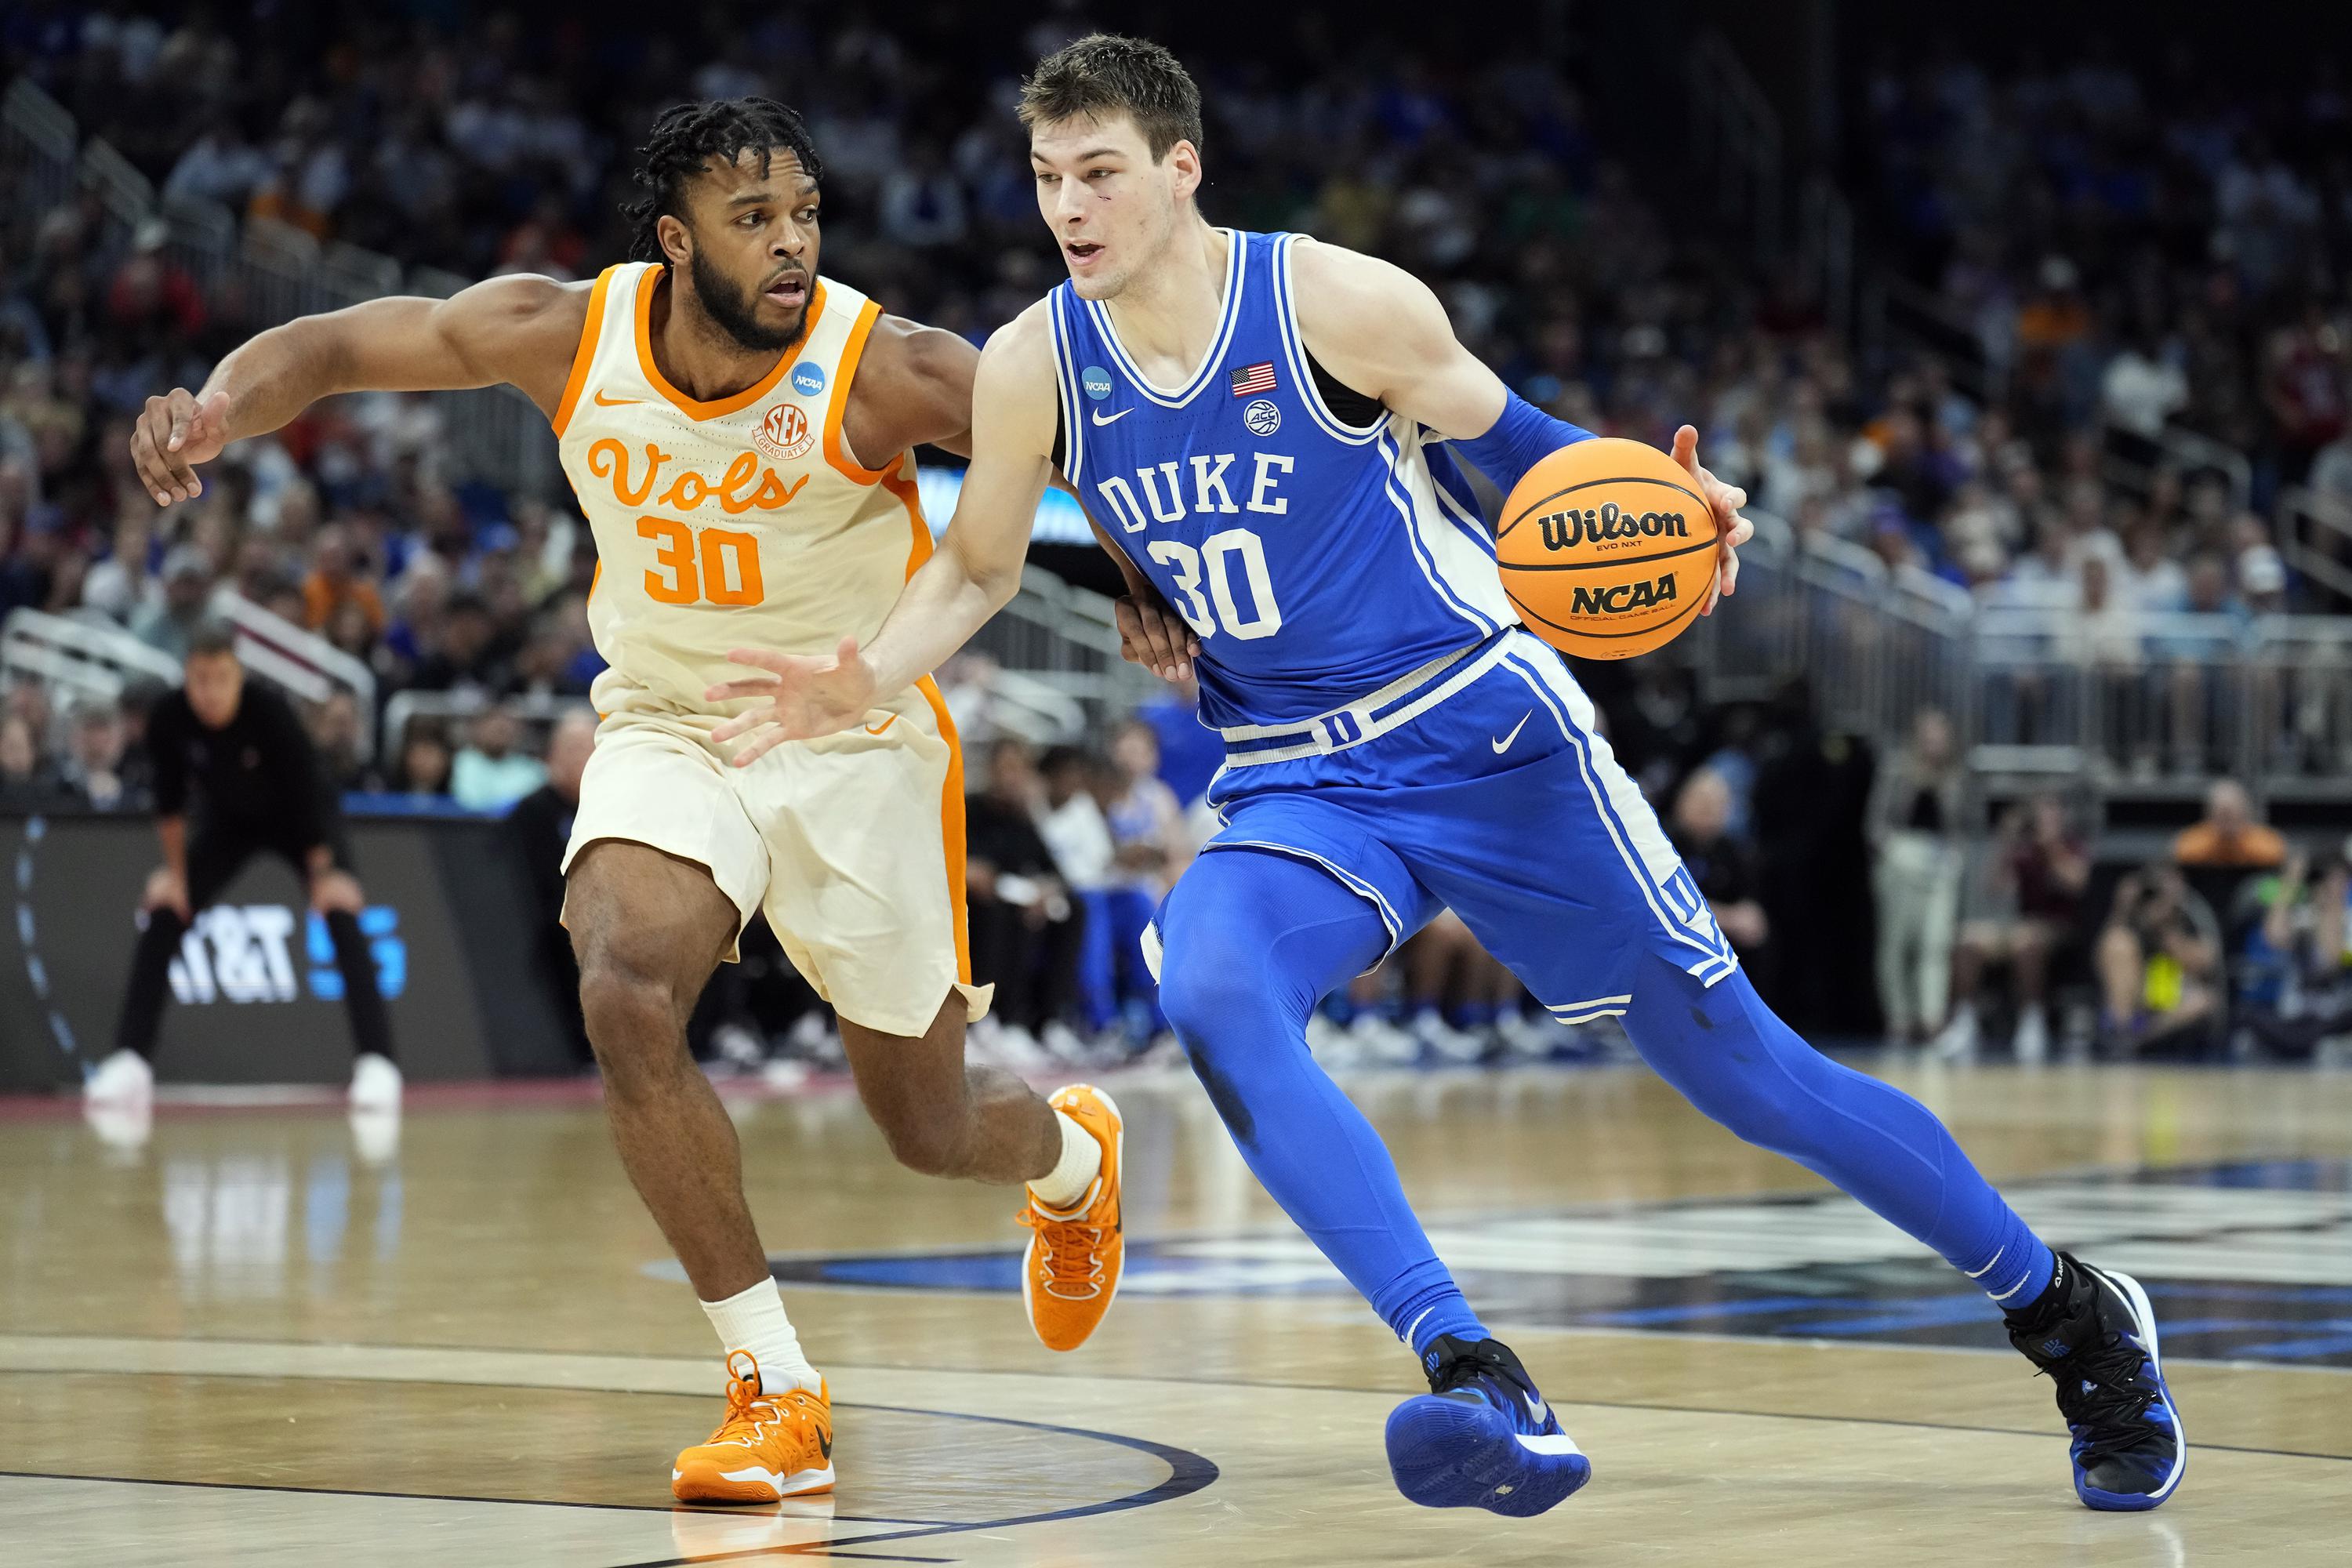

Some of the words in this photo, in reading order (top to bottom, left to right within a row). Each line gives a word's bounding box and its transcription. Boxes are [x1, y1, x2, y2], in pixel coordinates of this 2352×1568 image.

[795, 375, 823, 390] NCAA
[1085, 381, 1111, 392] NCAA
[767, 405, 806, 445] SEC
[1250, 409, 1276, 422] ACC
[758, 437, 807, 459] GRADUATE
[588, 437, 809, 514] Vols
[1098, 452, 1294, 533] DUKE
[1538, 502, 1689, 552] Wilson
[1596, 543, 1618, 552] EVO
[636, 514, 765, 606] 30
[1147, 528, 1283, 641] 30
[1570, 572, 1677, 615] NCAA
